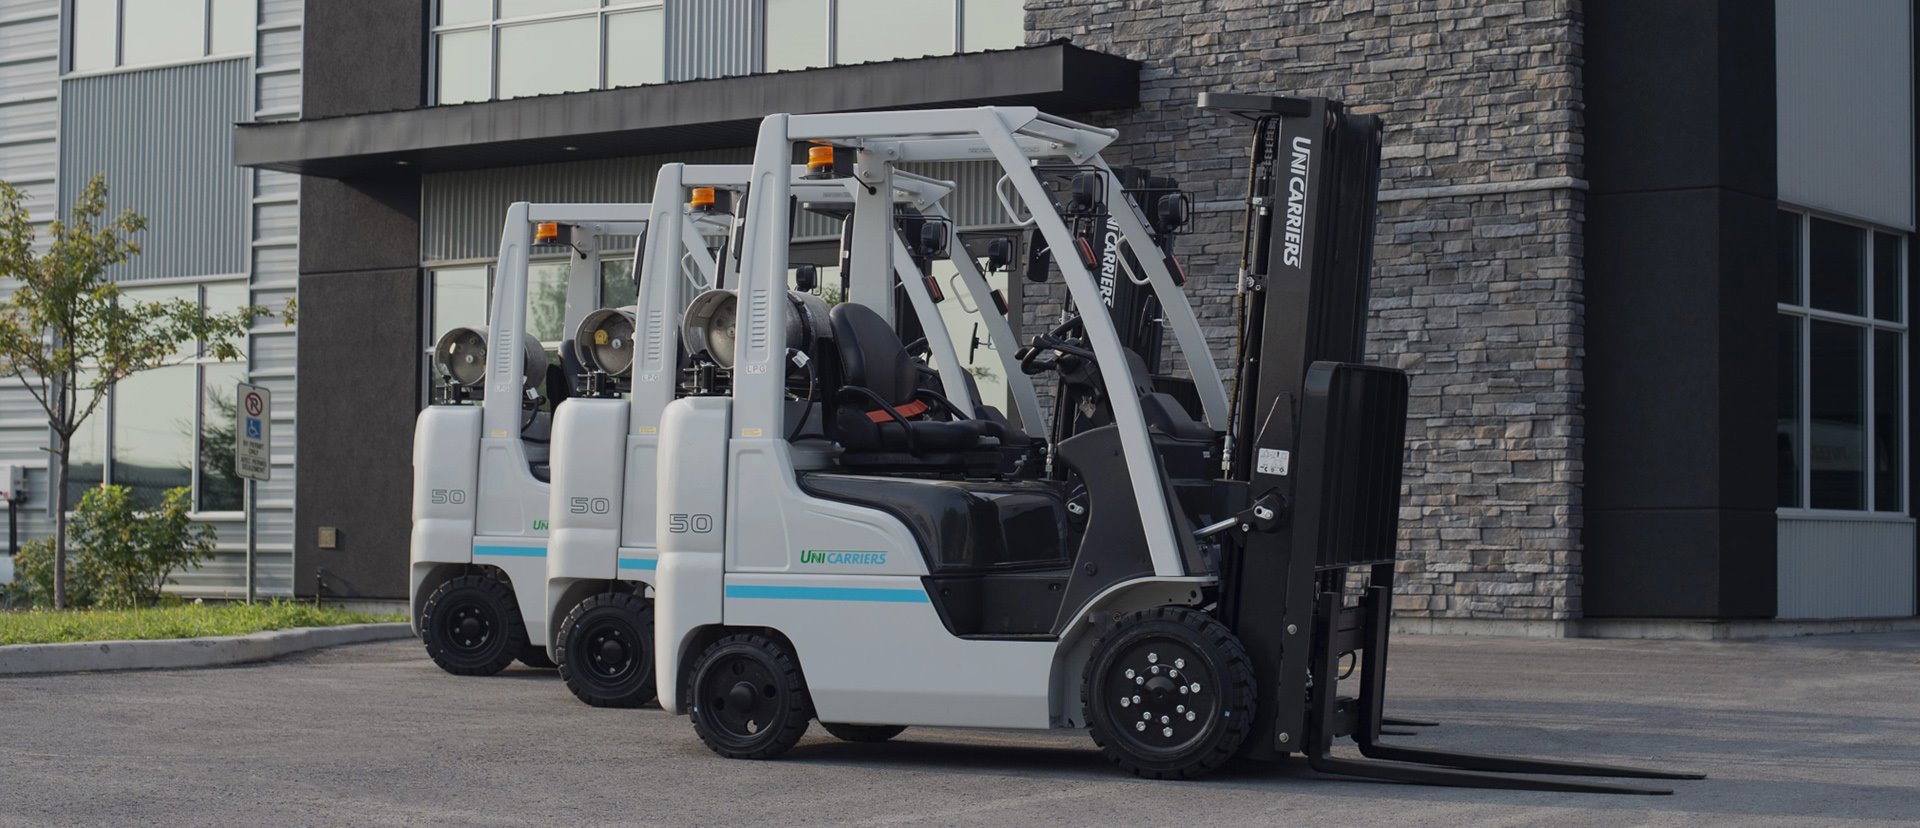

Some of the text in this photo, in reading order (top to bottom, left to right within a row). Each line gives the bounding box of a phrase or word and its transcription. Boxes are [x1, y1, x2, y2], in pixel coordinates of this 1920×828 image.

[1283, 136, 1312, 268] UNICARRIERS
[1100, 211, 1120, 307] NICARRIERS
[431, 489, 466, 505] 50
[570, 497, 610, 515] 50
[669, 513, 713, 534] 50
